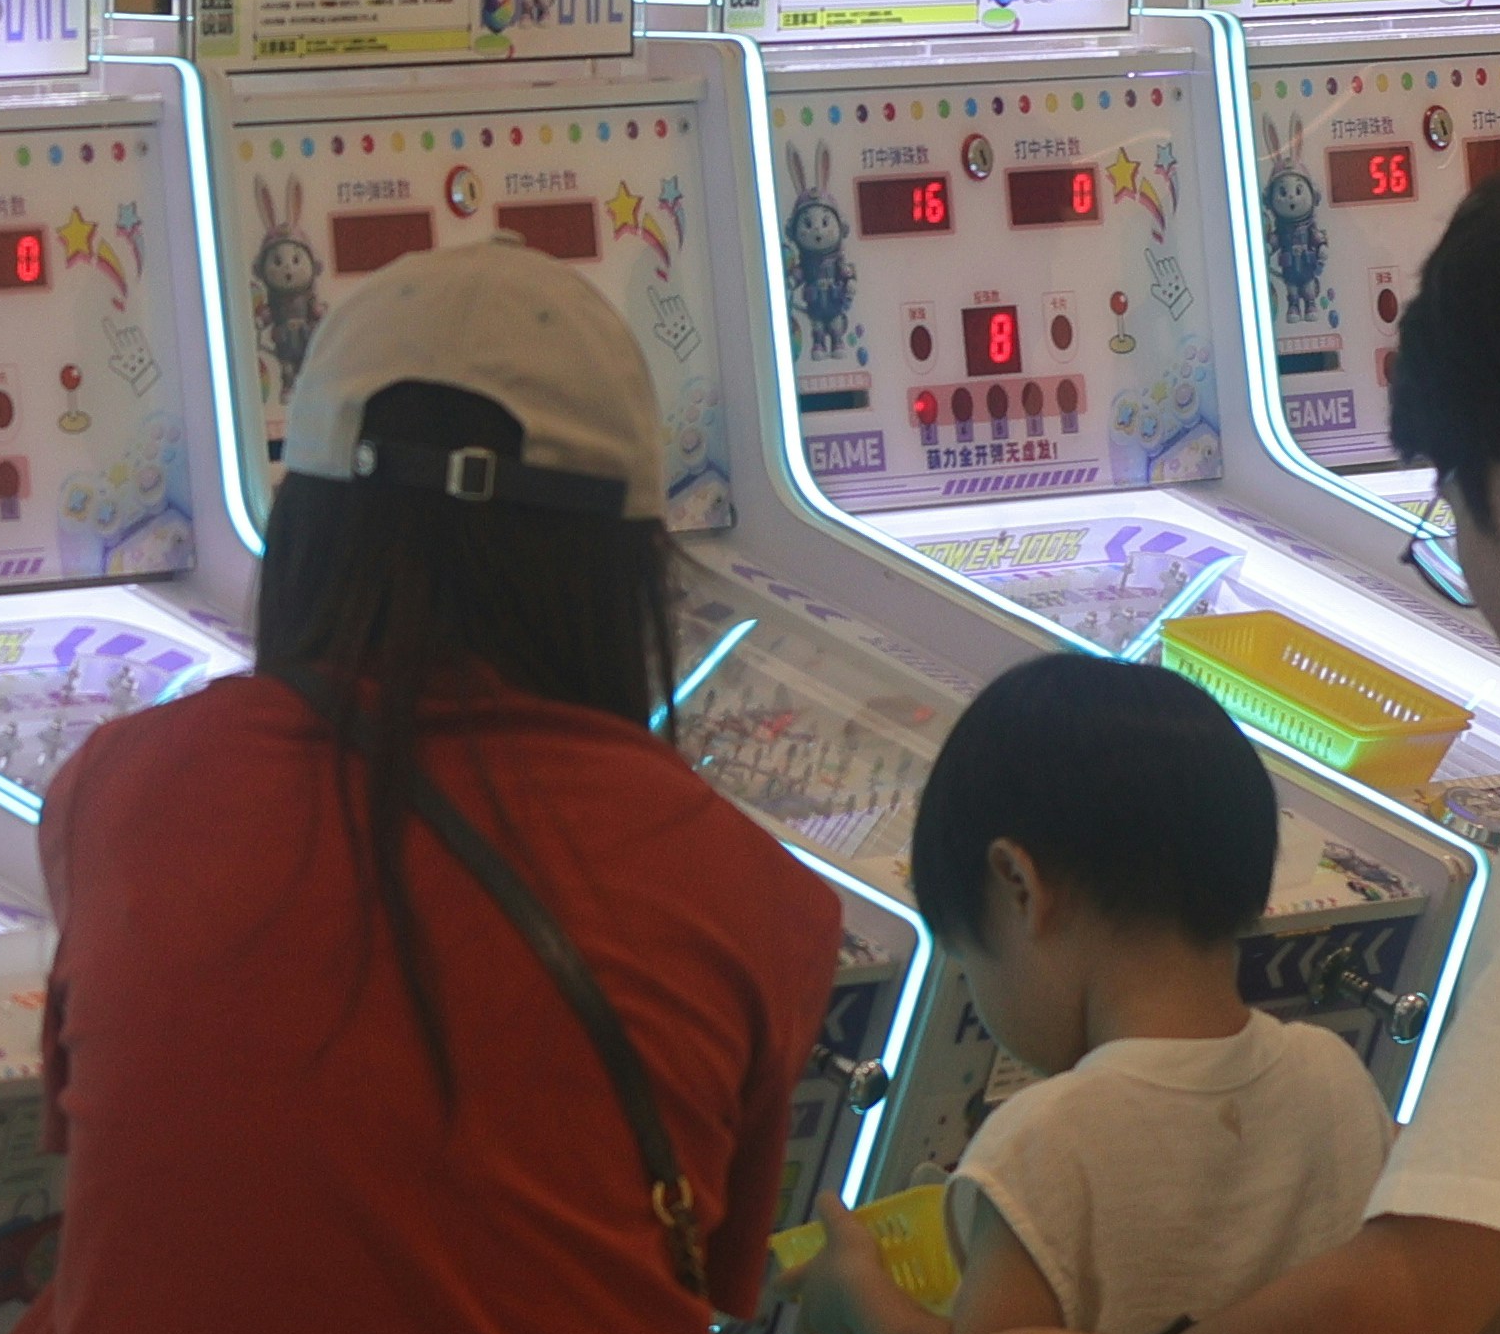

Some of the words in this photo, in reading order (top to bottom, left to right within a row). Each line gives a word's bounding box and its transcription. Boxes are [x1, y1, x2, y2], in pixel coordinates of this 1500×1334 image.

[1330, 113, 1396, 137] 打中弹珠数
[1014, 137, 1082, 161] 打中卡片数
[1072, 172, 1093, 216] 0
[14, 233, 42, 283] 0
[988, 312, 1013, 364] 8
[1285, 395, 1352, 429] GAME
[808, 435, 881, 470] GAME
